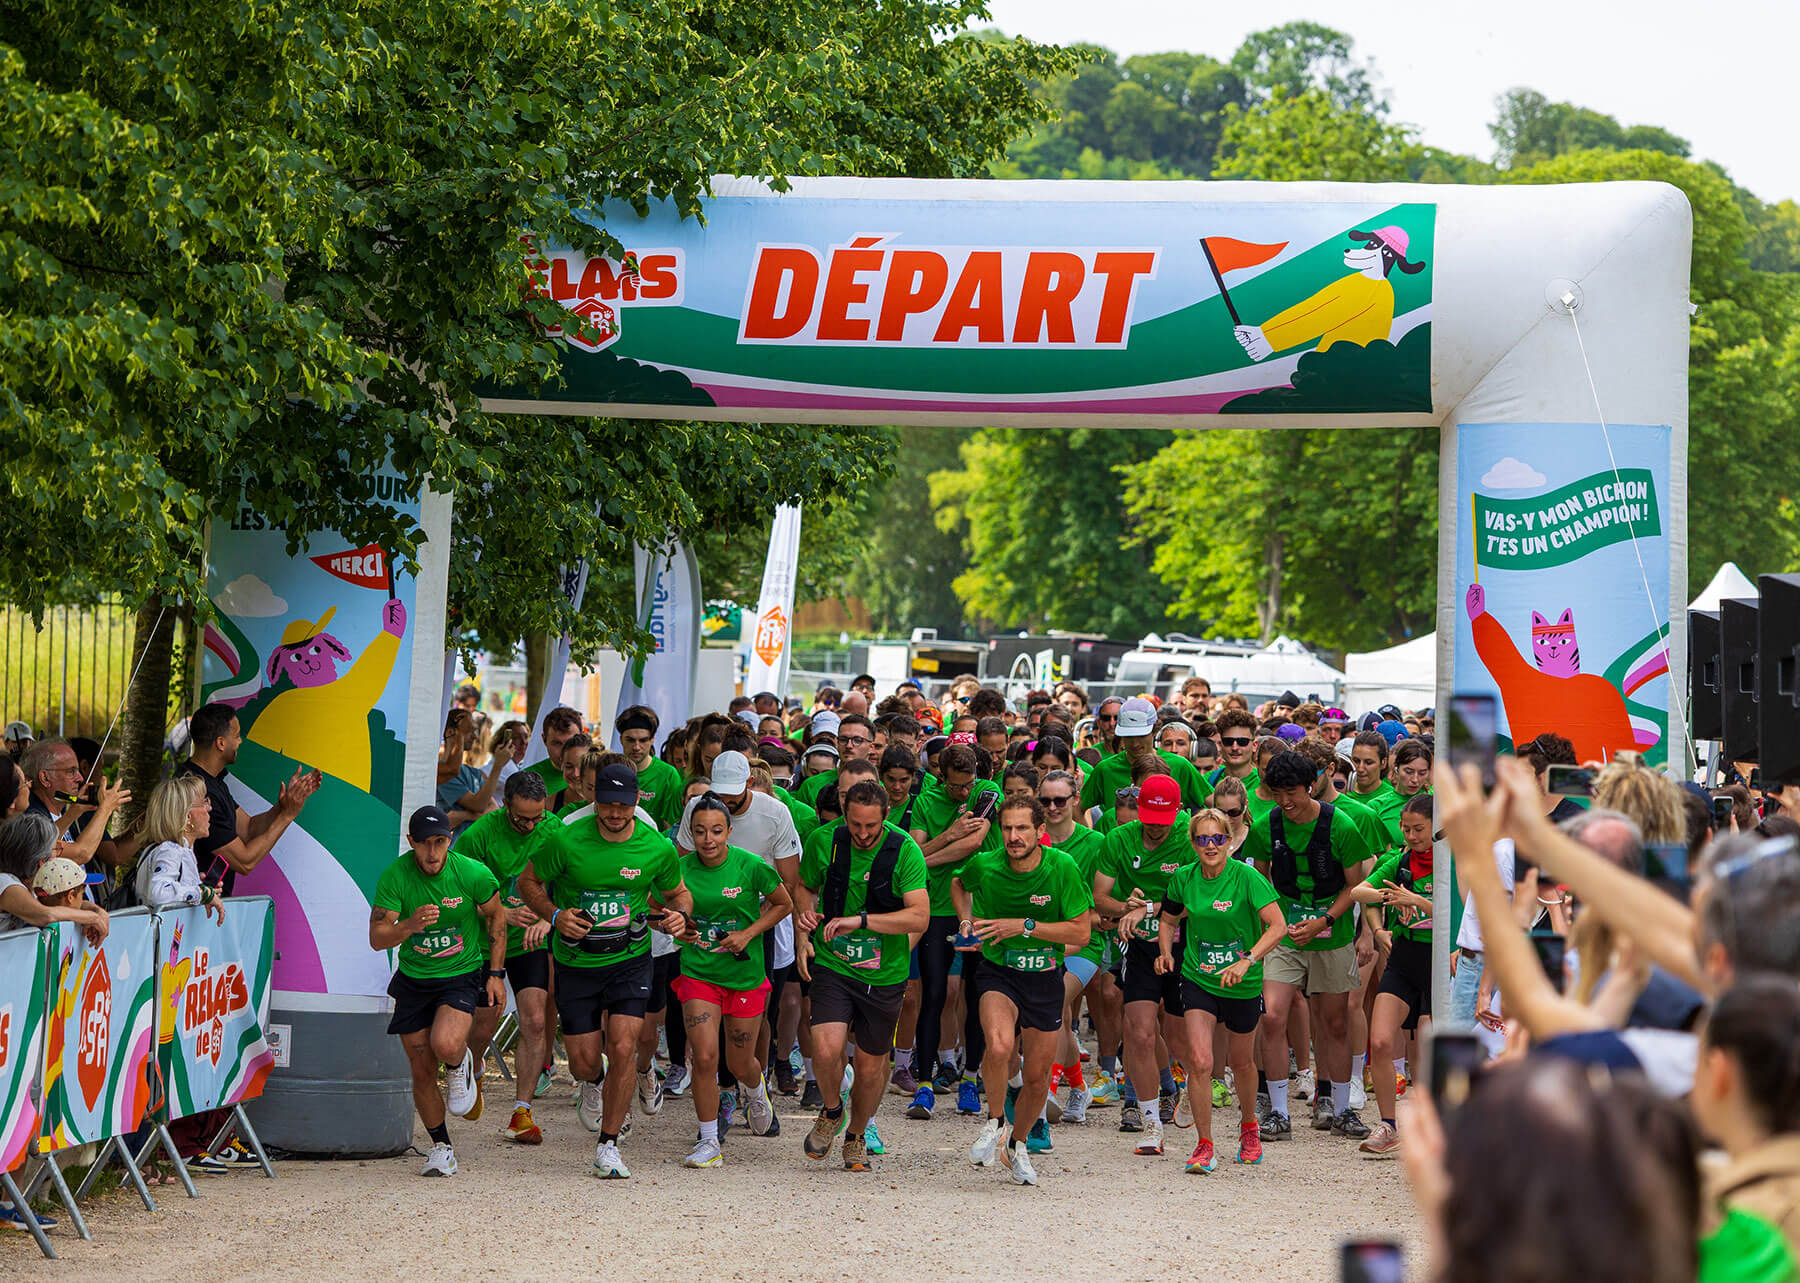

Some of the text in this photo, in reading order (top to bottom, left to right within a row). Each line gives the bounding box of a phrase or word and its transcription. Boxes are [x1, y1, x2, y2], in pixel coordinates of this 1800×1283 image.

[743, 237, 1156, 343] DÉPART
[1484, 481, 1648, 532] VAS-Y MON BICHON
[1486, 534, 1519, 556] T'ES
[1521, 535, 1549, 555] UN
[1549, 503, 1641, 549] CHAMPION
[330, 552, 384, 577] MERCI
[590, 902, 619, 915] 418
[422, 935, 451, 948] 419
[846, 944, 863, 958] 51
[1207, 951, 1234, 964] 354
[1017, 955, 1045, 968] 315
